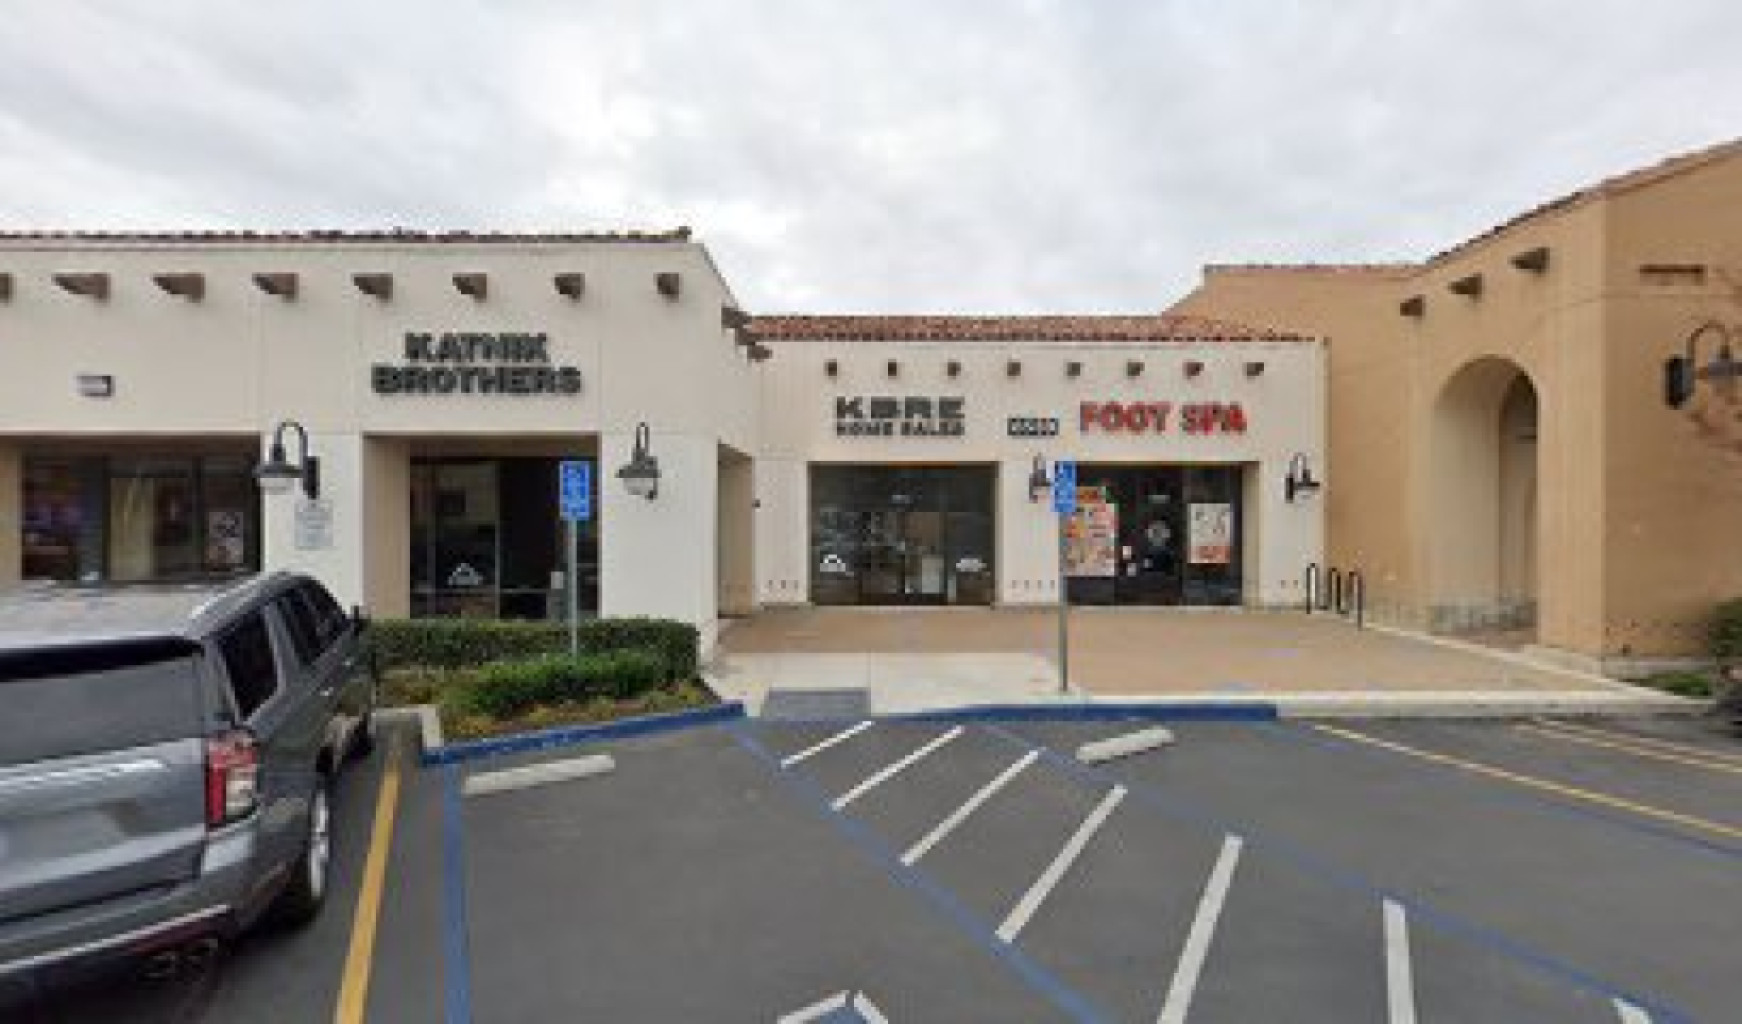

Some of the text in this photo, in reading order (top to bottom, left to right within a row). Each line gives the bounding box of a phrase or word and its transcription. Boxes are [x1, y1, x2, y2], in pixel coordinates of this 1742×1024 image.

[404, 332, 549, 362] KATNIK
[371, 364, 583, 395] BROTHERS
[835, 395, 966, 419] KBRE
[1079, 400, 1172, 434] FOOT
[1180, 402, 1247, 435] SPA
[835, 421, 966, 436] HOME SALES
